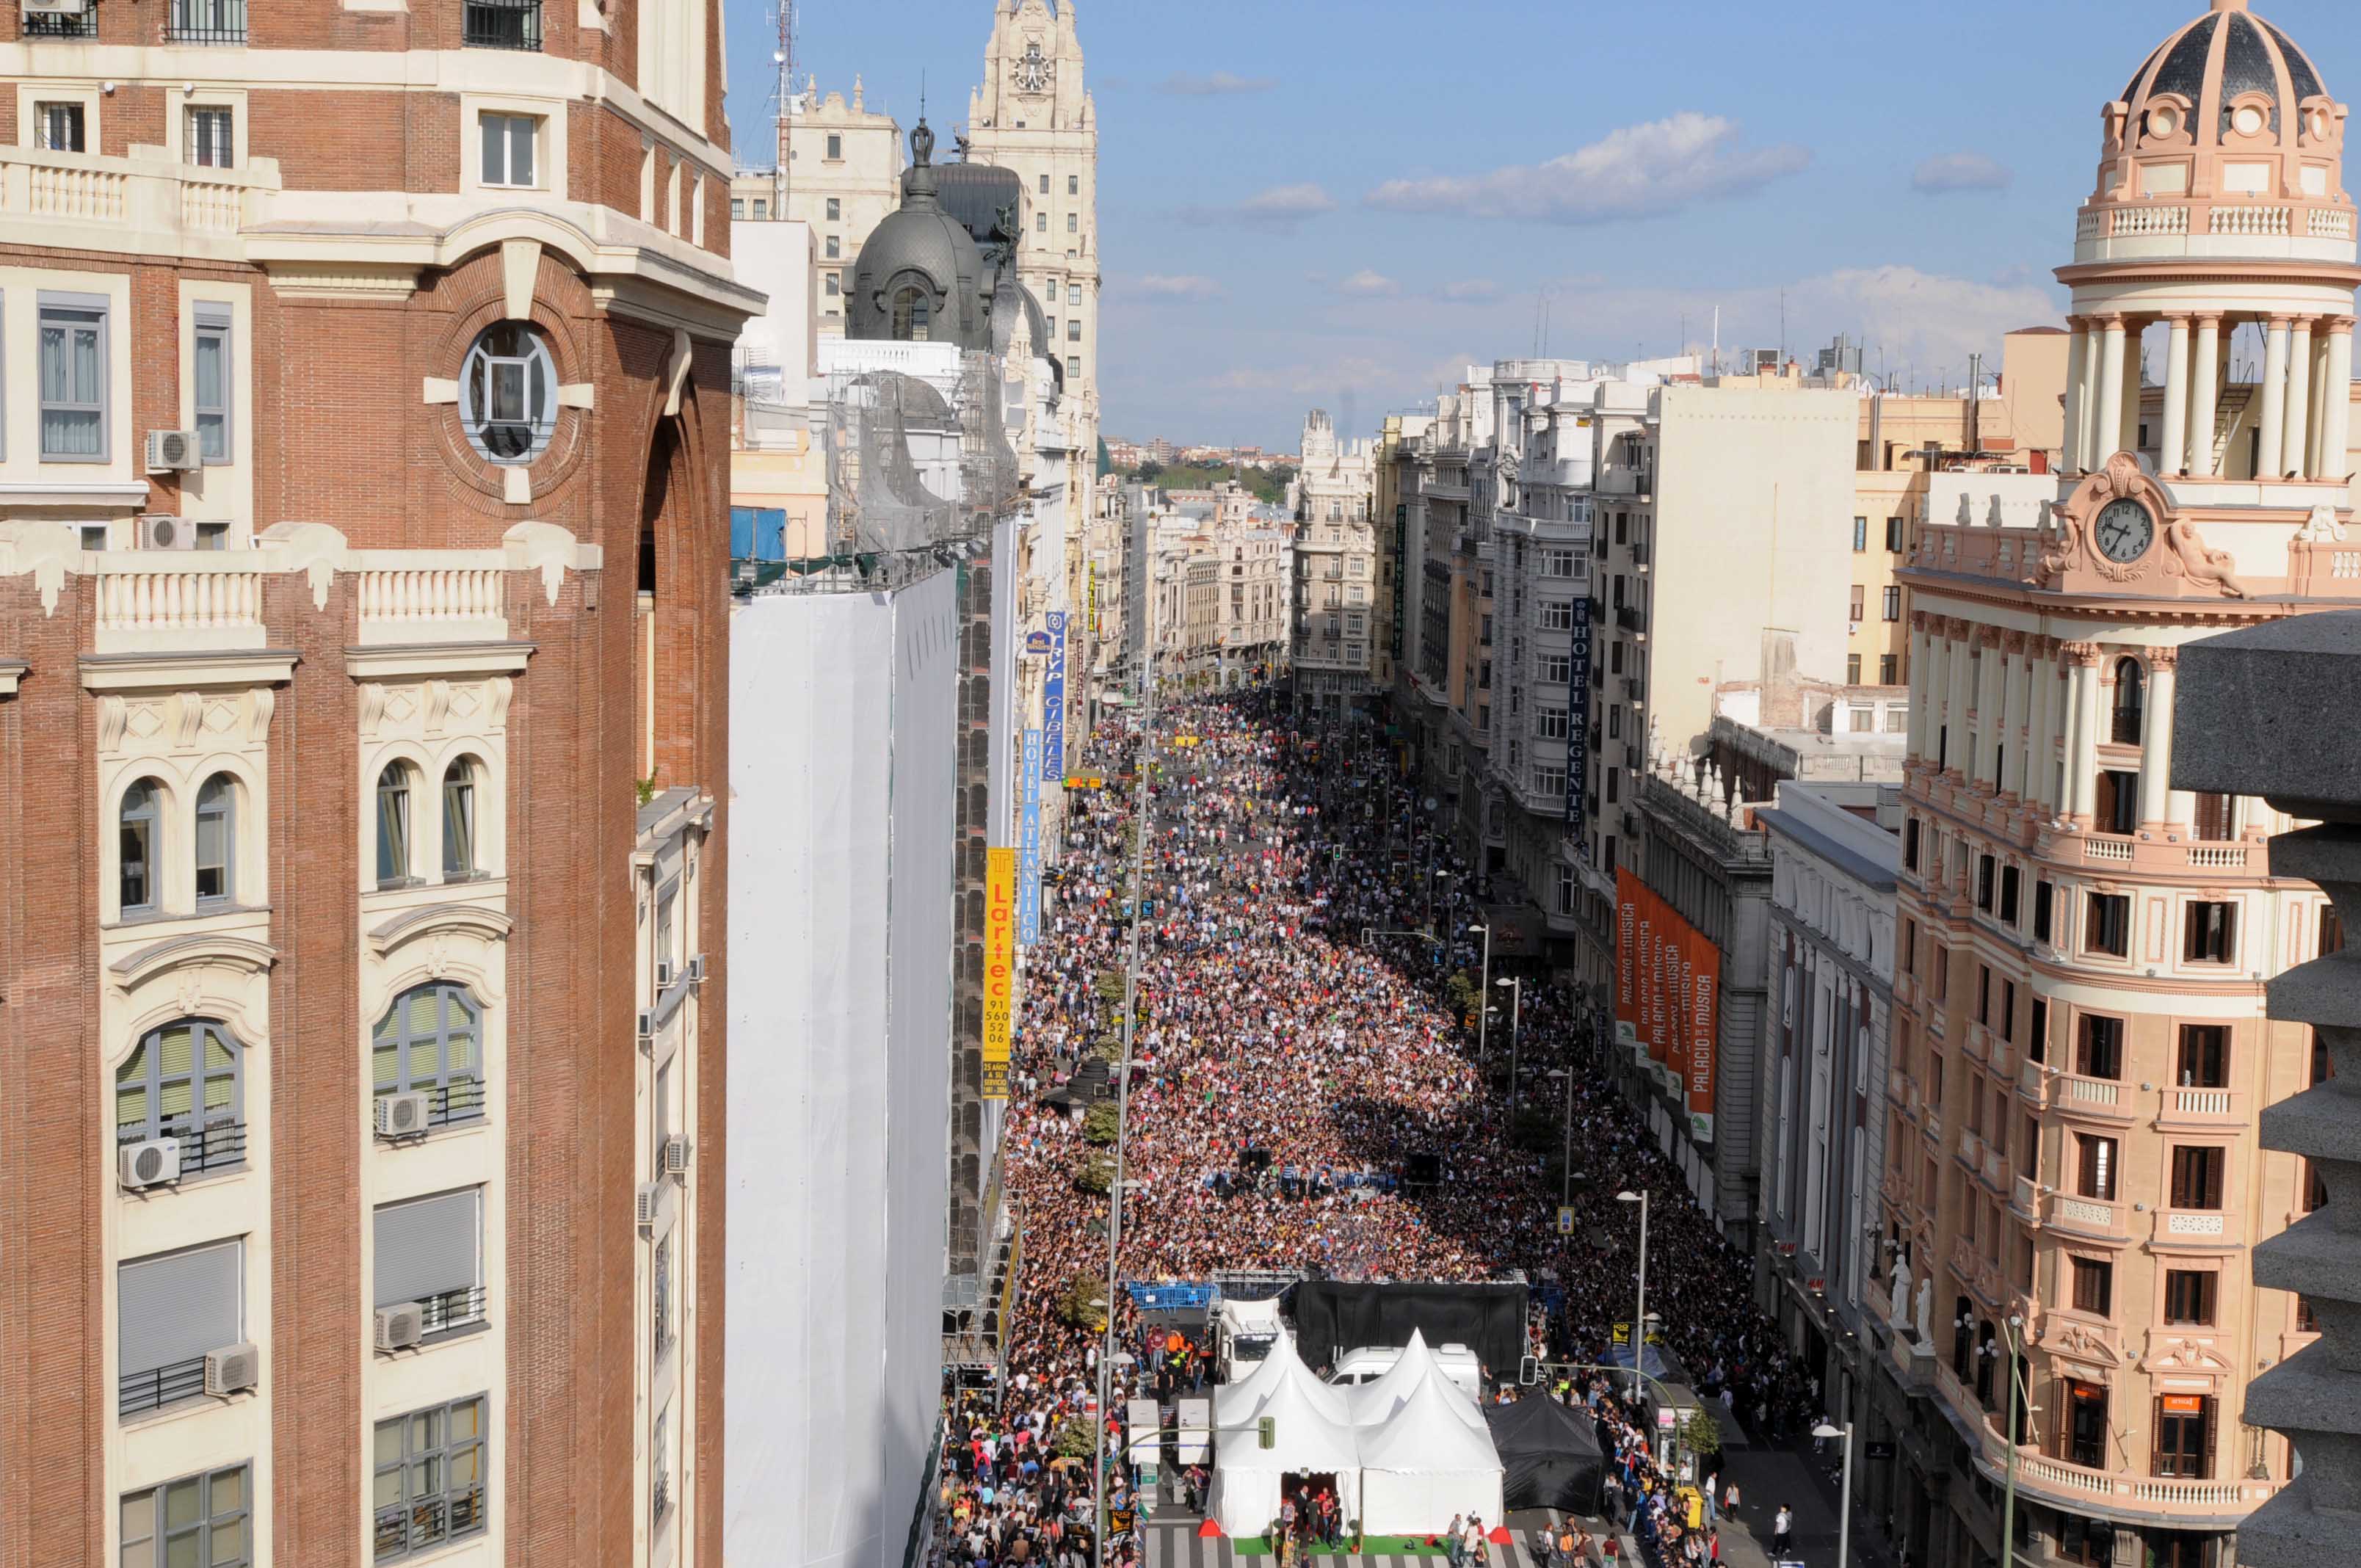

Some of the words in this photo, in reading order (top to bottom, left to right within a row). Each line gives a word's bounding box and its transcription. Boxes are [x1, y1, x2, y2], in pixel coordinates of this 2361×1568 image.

[2113, 508, 2119, 518] 11
[2122, 505, 2130, 515] 12
[2134, 505, 2138, 518] 1
[2105, 517, 2114, 526] 10
[2140, 518, 2147, 527] 2
[2144, 527, 2149, 537] 3
[2104, 537, 2109, 546] 8
[2138, 539, 2144, 548] 4
[2121, 548, 2127, 558] 6
[2132, 545, 2138, 554] 5
[1046, 634, 1062, 682] TRYP
[1573, 626, 1587, 704] HOTEL
[1045, 697, 1062, 780] CIBELES
[1026, 736, 1037, 804] HOTEL
[1568, 712, 1584, 822] REGENTE
[1023, 813, 1036, 940] ATLANTICO
[990, 884, 1007, 996] Lartec
[990, 1000, 1003, 1009] 91
[1692, 975, 1711, 1026] MÚSICA
[986, 1012, 1009, 1021] 560
[989, 1023, 1004, 1032] 52
[989, 1034, 1004, 1043] 06
[984, 1063, 991, 1071] 25
[1693, 1039, 1710, 1092] PALACIO
